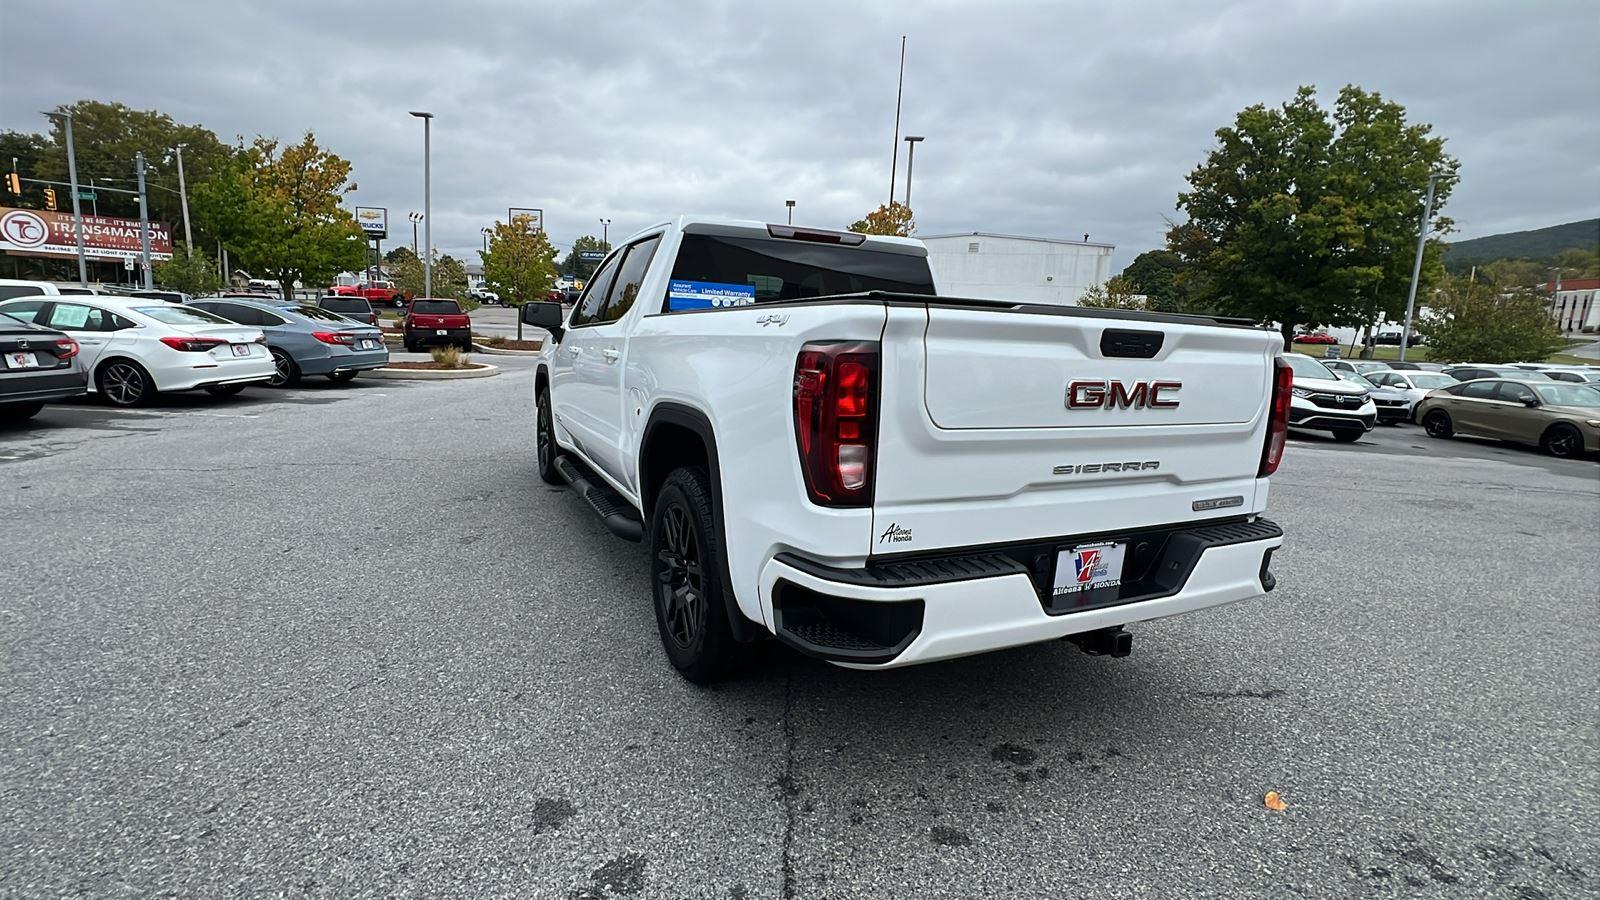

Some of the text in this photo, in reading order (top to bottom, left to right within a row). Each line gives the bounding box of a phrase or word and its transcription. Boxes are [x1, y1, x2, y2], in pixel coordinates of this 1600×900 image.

[51, 222, 168, 241] TRANS4MATON
[701, 288, 724, 296] Limited
[724, 290, 752, 298] Warranty
[1065, 378, 1182, 410] GMC
[1052, 461, 1160, 475] SIERRA
[893, 535, 912, 543] Honda
[1093, 579, 1122, 589] HONDA
